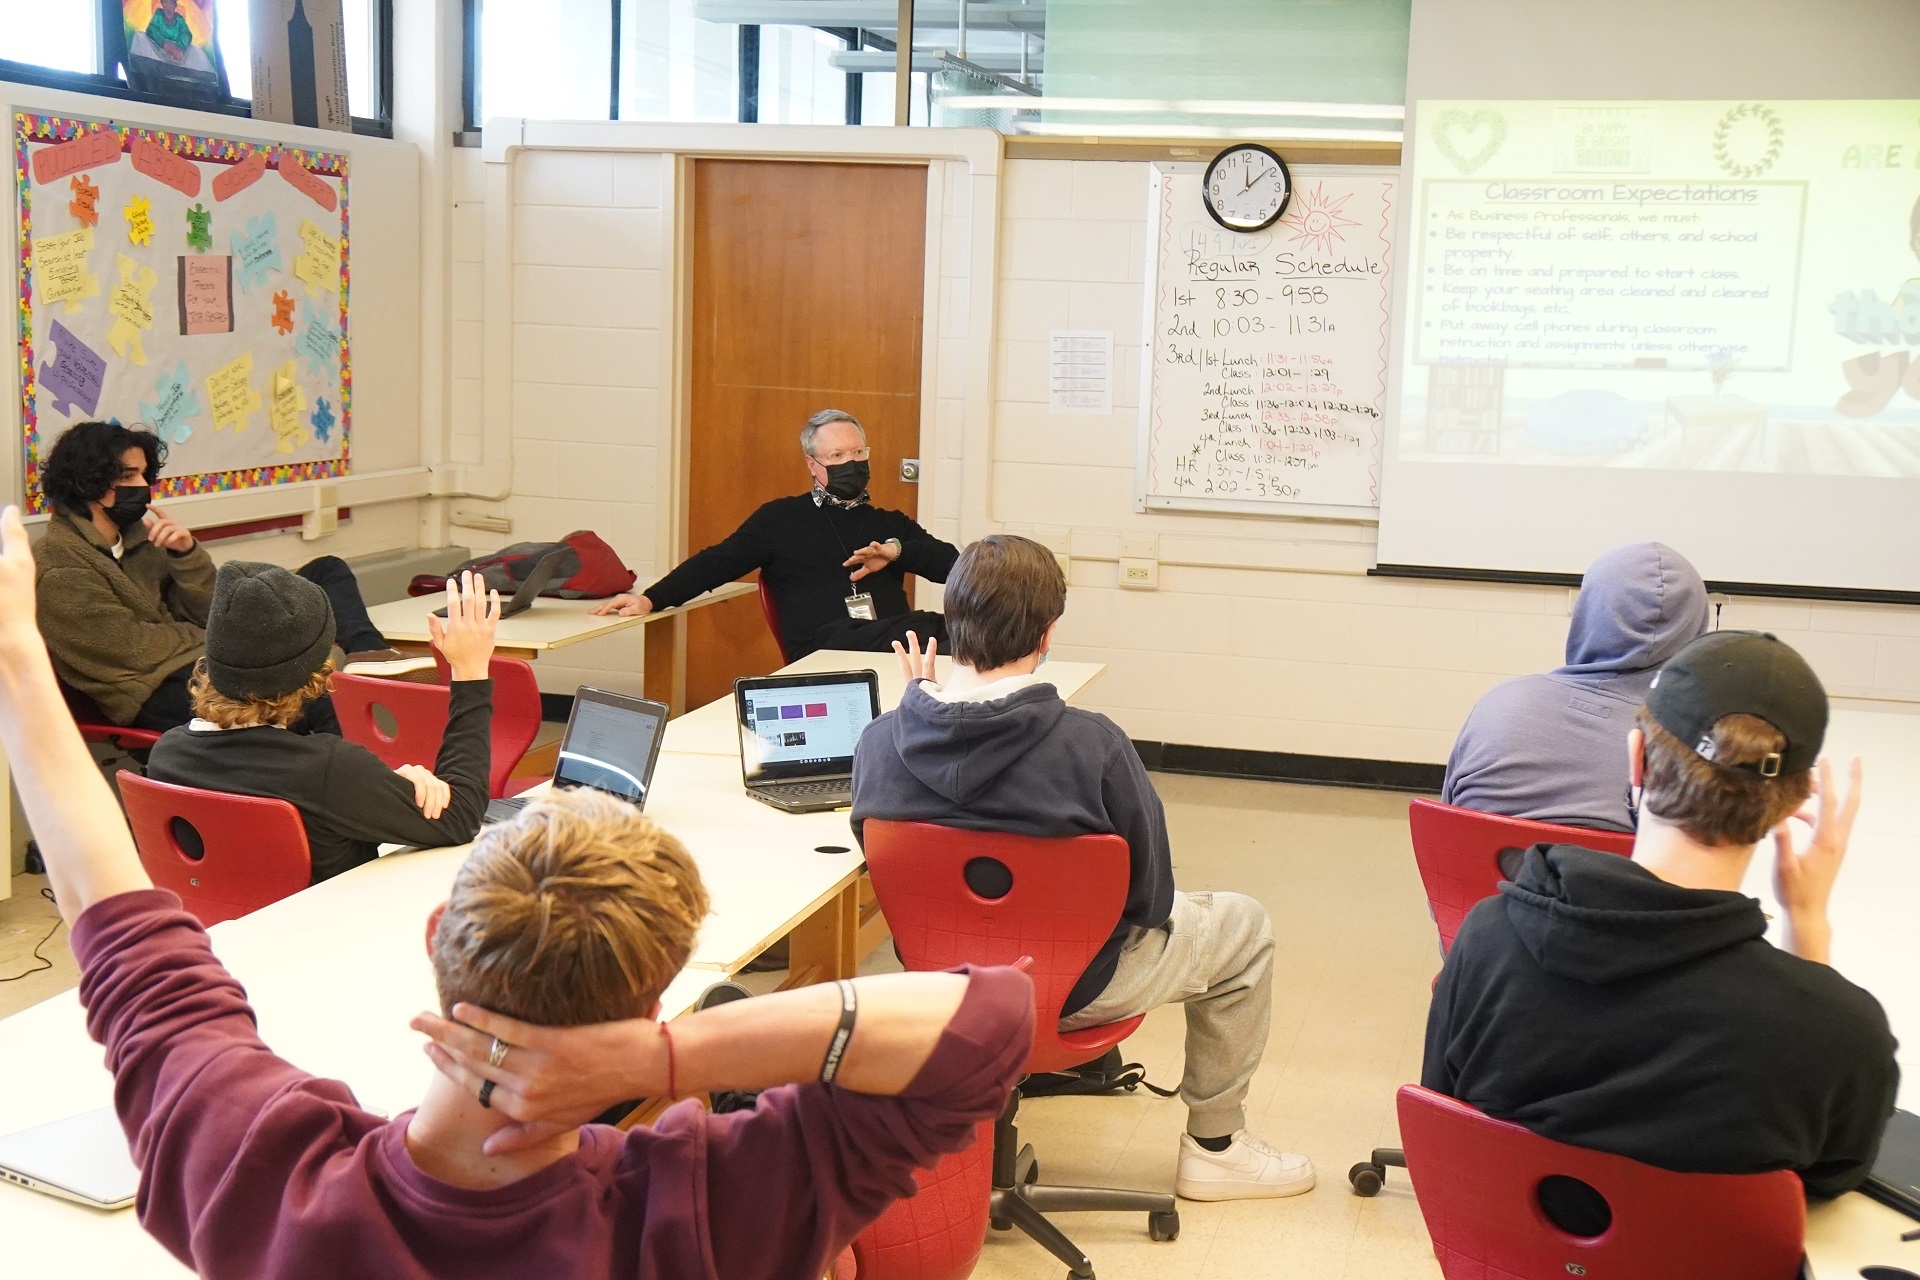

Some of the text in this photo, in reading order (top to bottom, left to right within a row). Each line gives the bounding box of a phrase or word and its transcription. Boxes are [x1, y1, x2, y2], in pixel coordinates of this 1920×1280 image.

[1598, 122, 1627, 134] HAPPY
[1592, 135, 1631, 148] BRIGHT
[39, 135, 116, 182] PUZZLED
[139, 142, 198, 190] ABOUT
[1227, 157, 1236, 168] 11
[1241, 152, 1253, 163] 12
[1260, 156, 1264, 166] 1
[1842, 144, 1903, 170] ARE
[1216, 169, 1227, 180] 10
[1269, 167, 1277, 177] 2
[1213, 184, 1220, 195] 9
[1274, 182, 1281, 193] 3
[1485, 183, 1758, 207] Classroom Expectations
[1217, 200, 1224, 210] 8
[1270, 198, 1277, 207] 4
[1259, 209, 1266, 220] 5
[1446, 209, 1464, 221] As
[1470, 209, 1529, 221] Business
[1534, 208, 1631, 222] Professionals,
[1637, 213, 1659, 222] we
[1446, 226, 1758, 245] Be respectful of self, others, and school
[1184, 248, 1383, 281] Regular Schedule
[1444, 264, 1464, 277] Be
[1470, 267, 1487, 277] on
[1493, 264, 1523, 277] time
[1528, 265, 1554, 278] and
[1559, 265, 1629, 283] prepared
[1634, 267, 1650, 278] to
[1656, 267, 1694, 279] start
[1174, 284, 1330, 310] 1st 8:30 9:58
[1442, 282, 1769, 302] Keep your seating area cleaned and cleared
[1442, 298, 1461, 313] of
[1167, 313, 1202, 339] 2nd
[1213, 316, 1266, 338] 10:03
[1441, 319, 1716, 339] Put away cell phones during classroom
[1440, 336, 1748, 355] instruction and assignments unless otherwise
[1203, 382, 1222, 396] 2nd
[1176, 455, 1199, 473] HR
[1173, 475, 1195, 494] 4th
